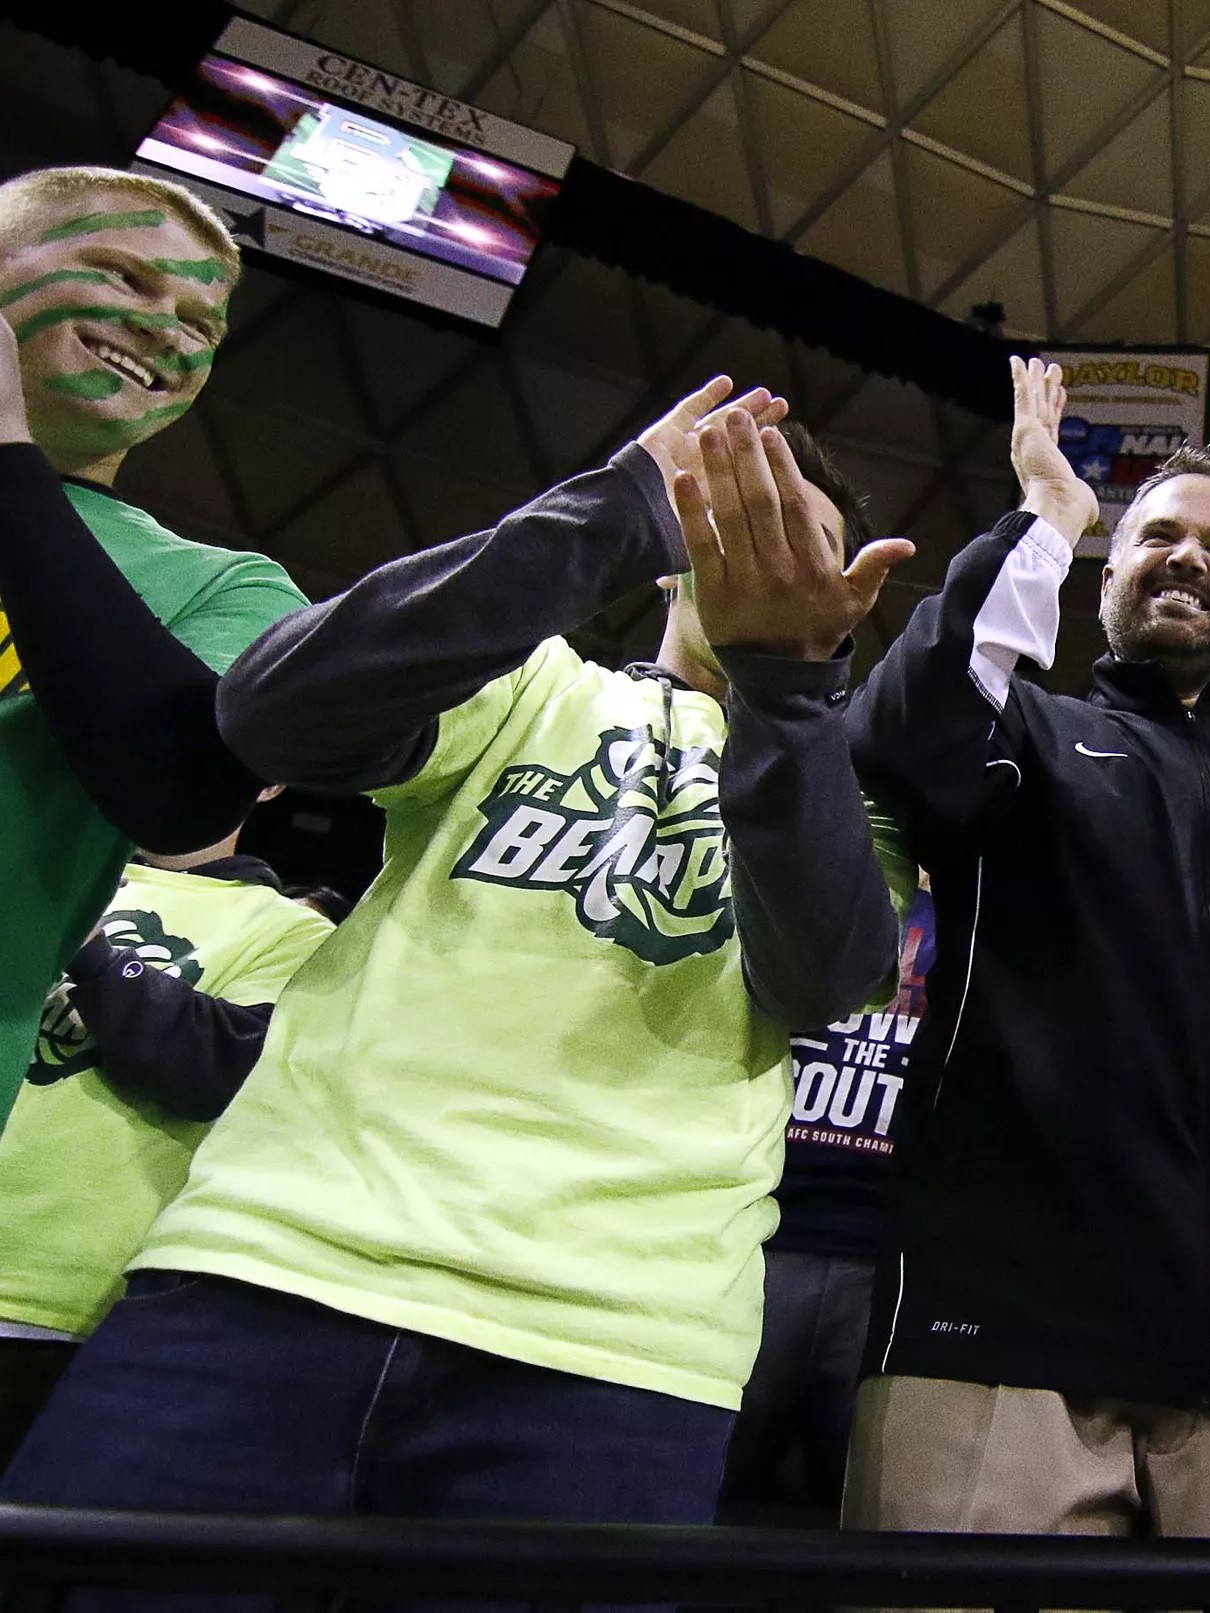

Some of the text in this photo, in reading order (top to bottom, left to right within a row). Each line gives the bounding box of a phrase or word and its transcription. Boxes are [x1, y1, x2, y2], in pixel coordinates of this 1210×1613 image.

[306, 70, 373, 101] ROOF
[316, 54, 488, 132] CEN-TEX
[498, 770, 563, 801] THE
[843, 1038, 891, 1068] THE
[792, 1060, 904, 1136] OUT
[787, 1128, 808, 1140] AFC
[812, 1130, 851, 1146] SOUTH
[931, 1321, 980, 1335] DRI-FIT
